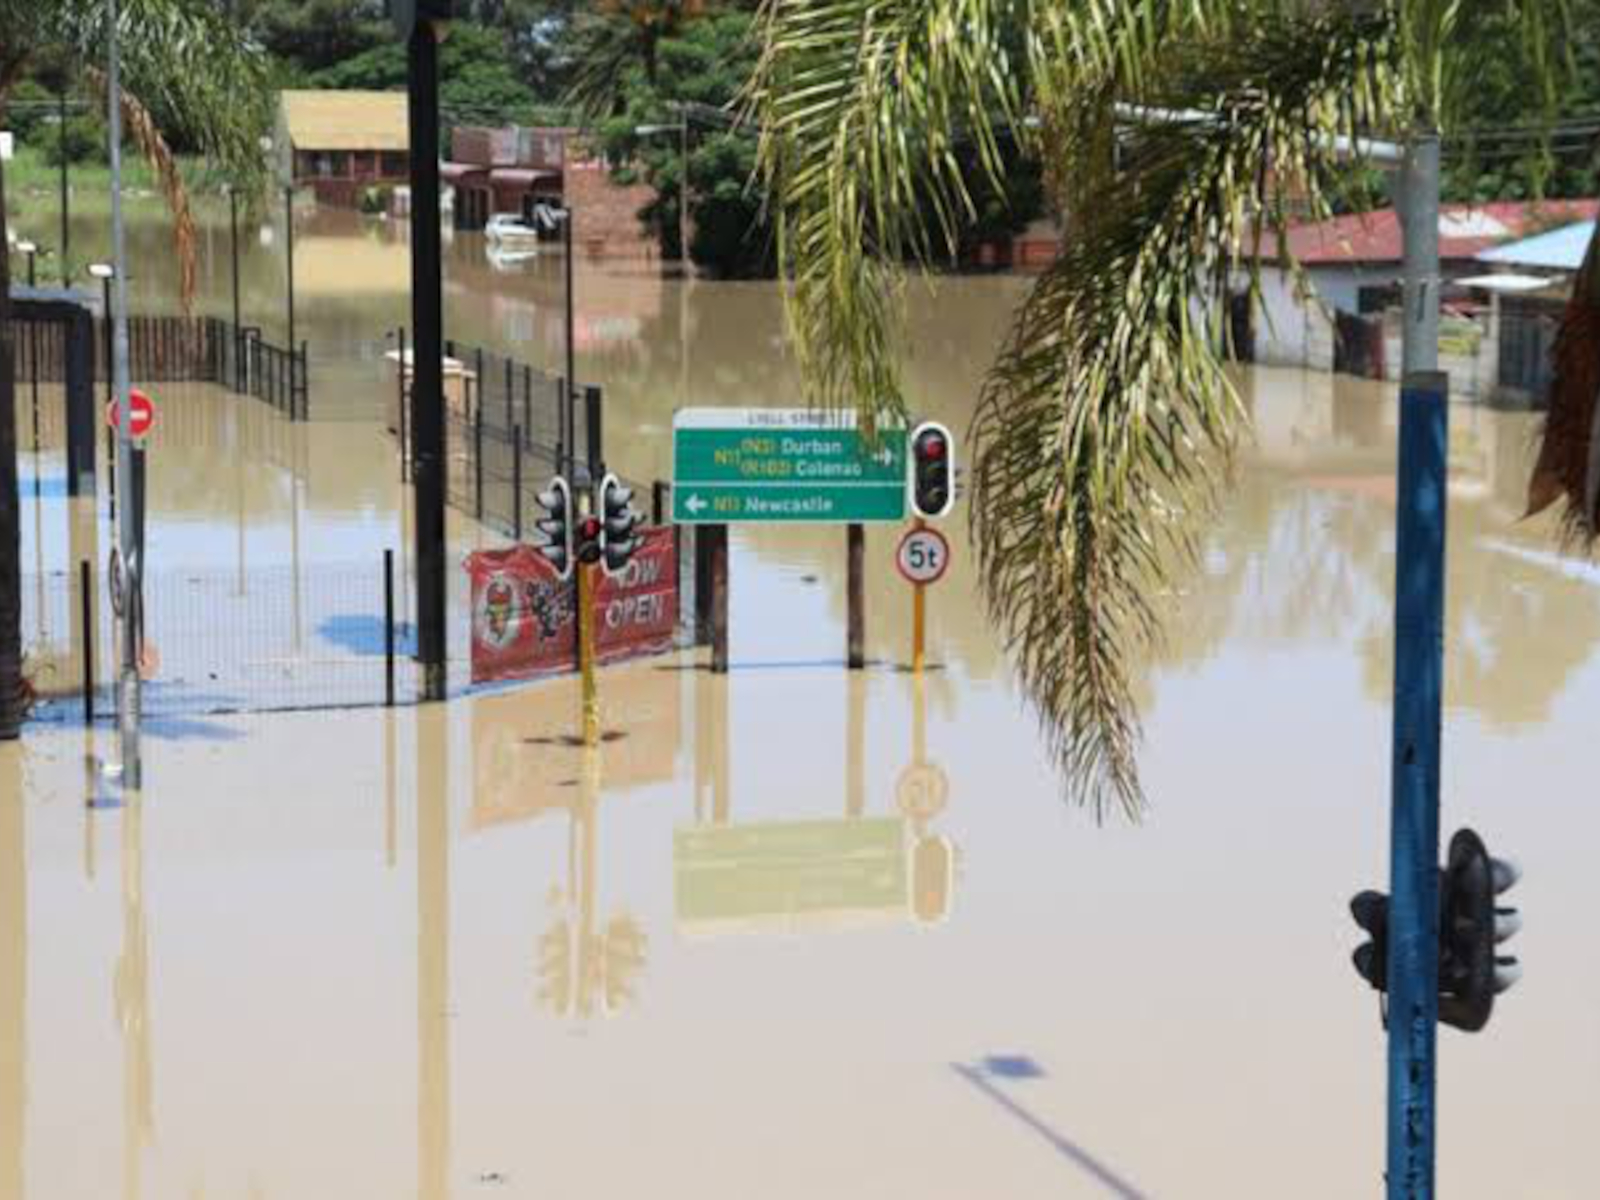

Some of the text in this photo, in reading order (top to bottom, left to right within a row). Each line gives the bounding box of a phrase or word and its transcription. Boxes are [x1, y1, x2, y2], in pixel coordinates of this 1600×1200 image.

[781, 437, 843, 455] Durban
[797, 459, 863, 477] Colenso
[745, 496, 834, 513] Newcastle
[908, 540, 937, 569] 5t
[605, 593, 664, 628] OPEN
